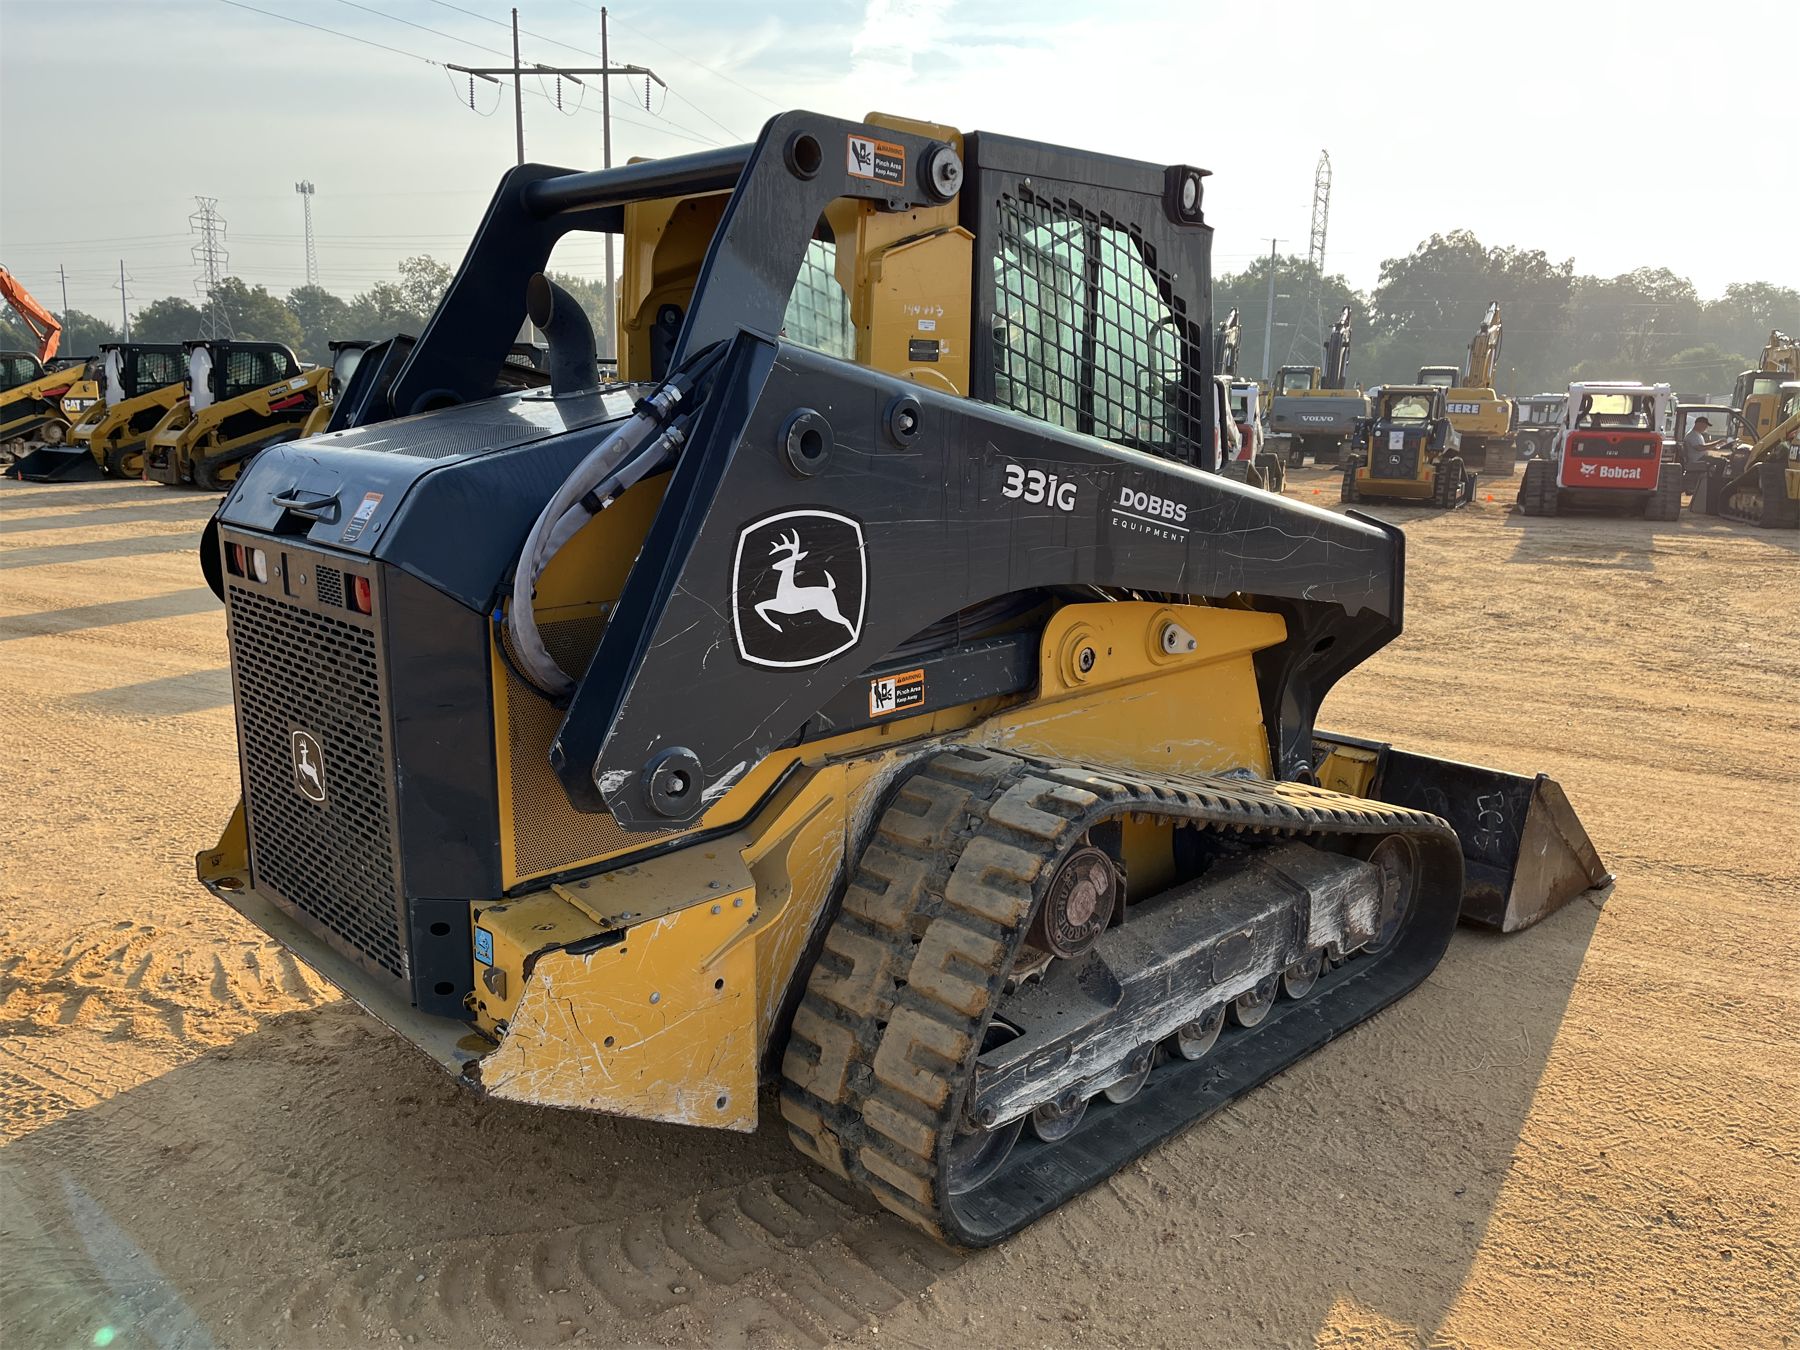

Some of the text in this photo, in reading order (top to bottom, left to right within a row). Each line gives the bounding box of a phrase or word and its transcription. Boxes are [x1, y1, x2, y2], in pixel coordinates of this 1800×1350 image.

[875, 158, 902, 170] Pinch Area
[875, 168, 898, 179] Keep Away
[64, 399, 81, 411] CAT
[1446, 403, 1479, 414] EERE
[1600, 466, 1640, 479] Bobcat
[1001, 464, 1077, 511] 331G
[1119, 487, 1188, 522] DOBBS
[1112, 517, 1185, 544] EQUIPMENT
[896, 688, 910, 697] Pinch
[896, 696, 907, 704] Keep
